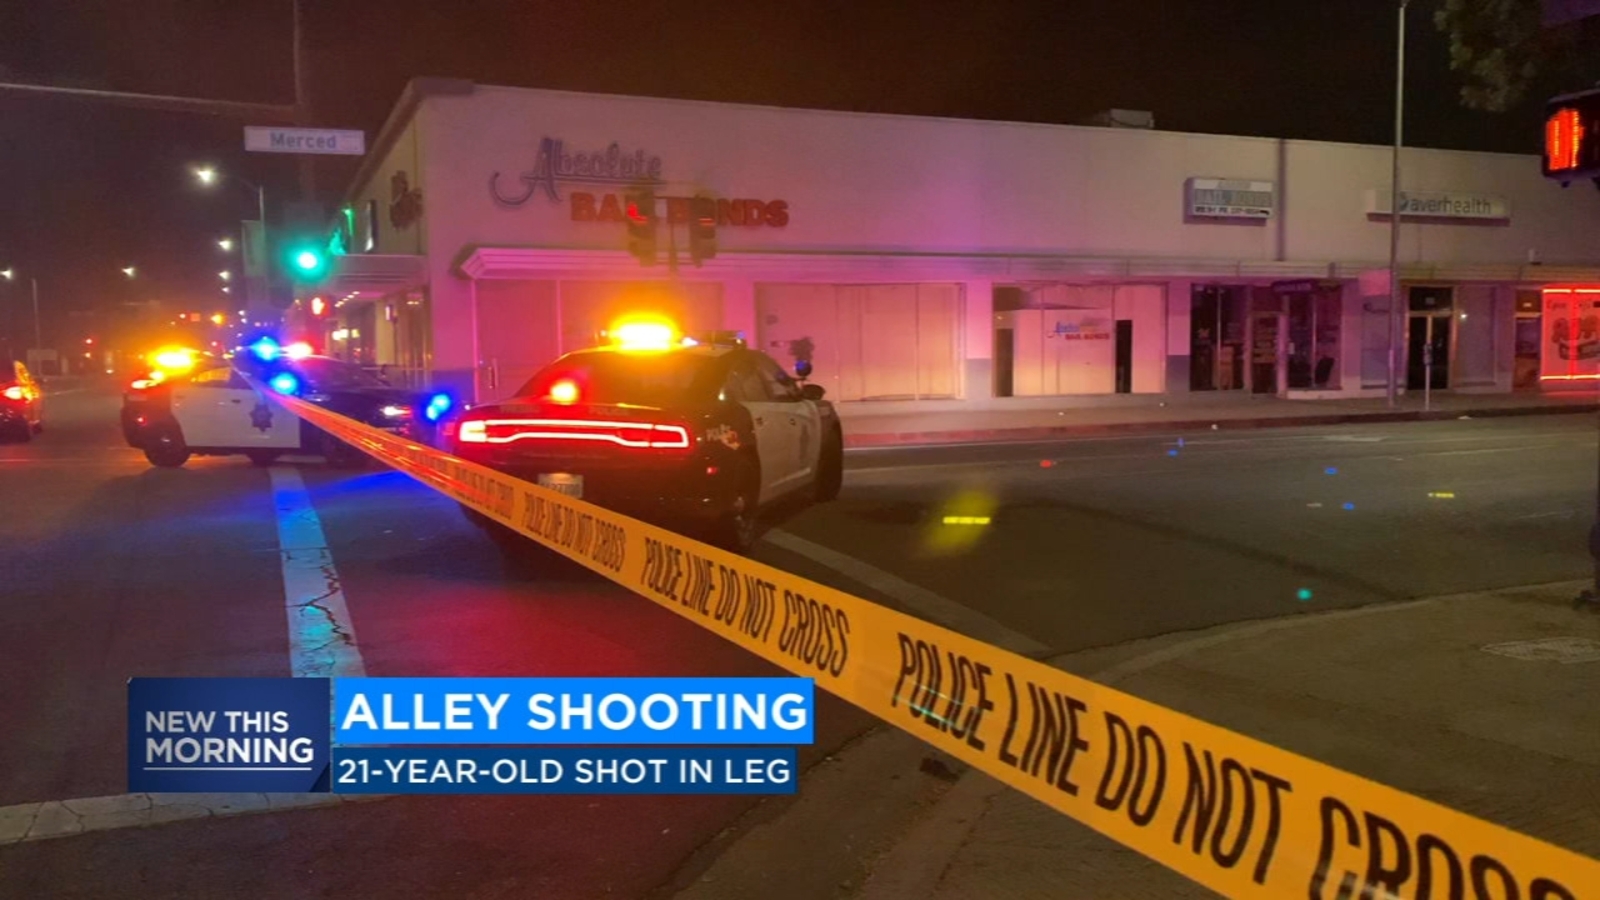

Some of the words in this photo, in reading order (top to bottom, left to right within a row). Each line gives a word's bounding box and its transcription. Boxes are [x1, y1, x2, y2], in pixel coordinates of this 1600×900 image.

[269, 131, 338, 149] Merced
[488, 136, 663, 206] Absolute
[1409, 196, 1492, 215] averhealth
[640, 536, 683, 602] POLICE
[681, 551, 715, 617] LINE
[714, 563, 741, 627] DO
[738, 573, 777, 644] NOT
[778, 588, 851, 678] CROSS
[891, 631, 995, 752] POLICE
[998, 672, 1090, 798] LINE
[1094, 710, 1167, 828] DO
[1172, 740, 1294, 886] NOT
